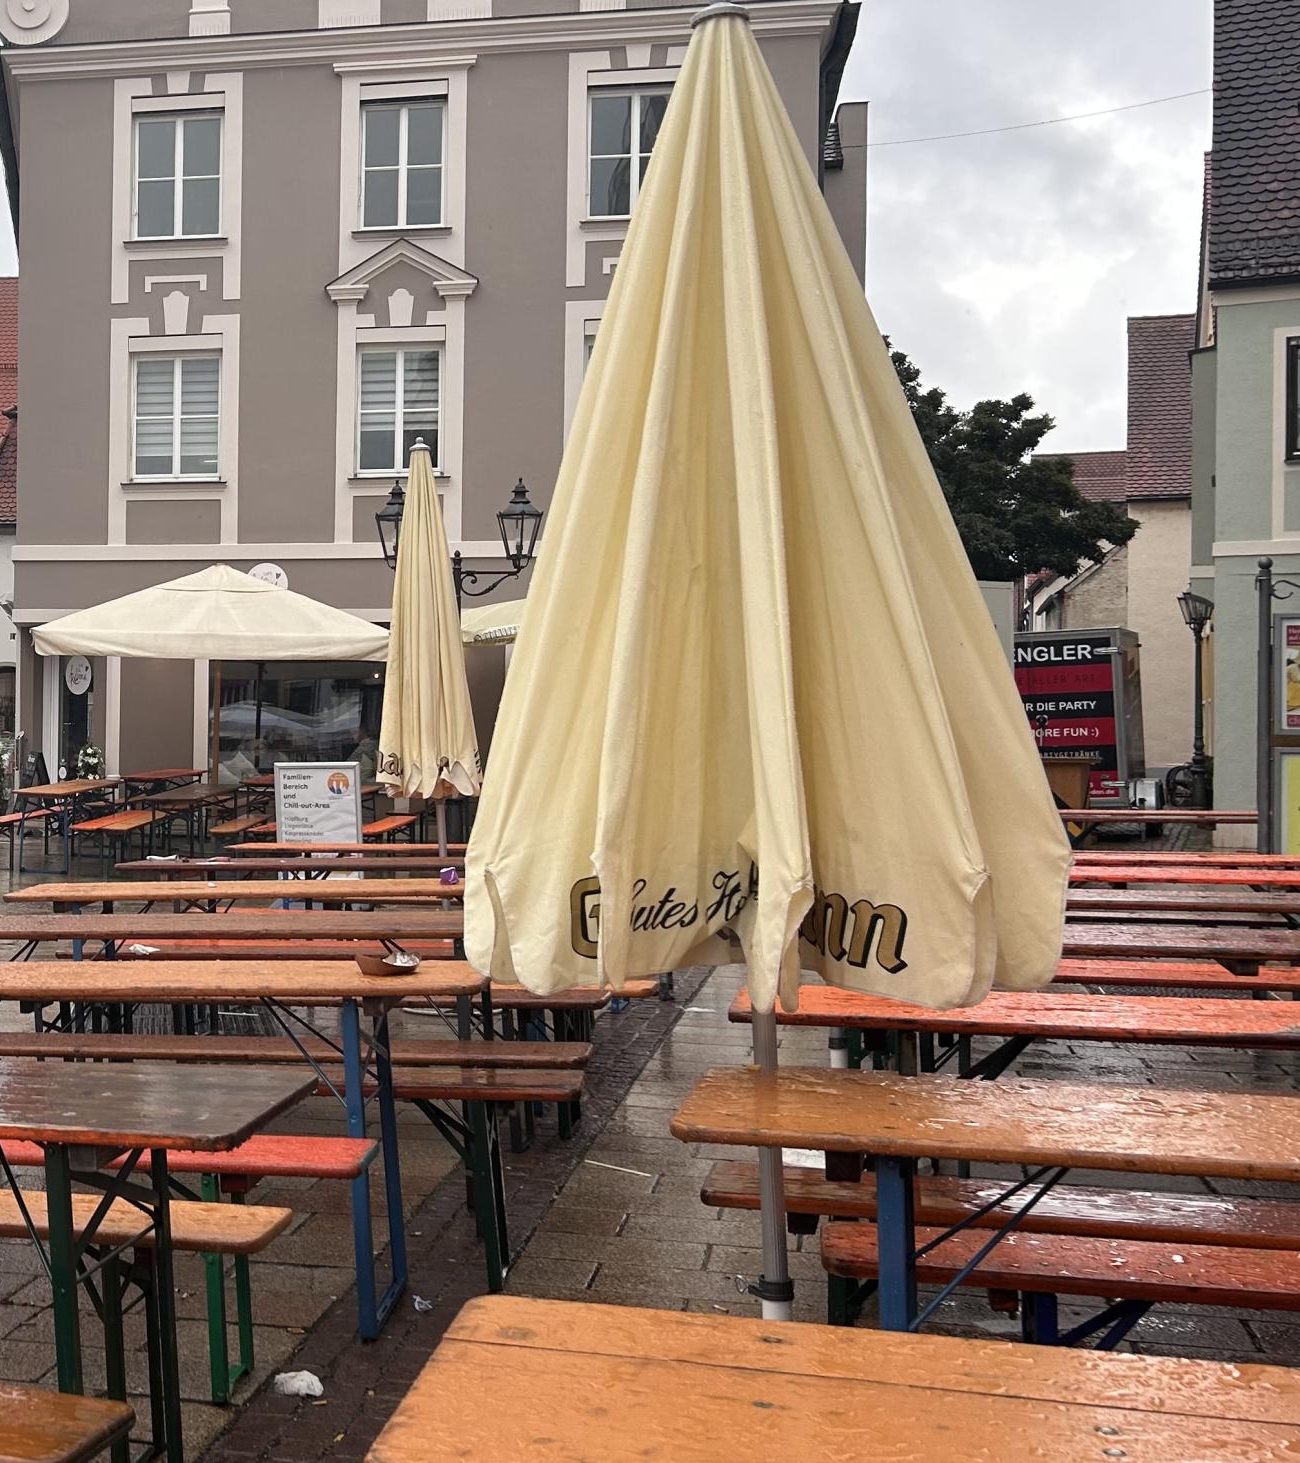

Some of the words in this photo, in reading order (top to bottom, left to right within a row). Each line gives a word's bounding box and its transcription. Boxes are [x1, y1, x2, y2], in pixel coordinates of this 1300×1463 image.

[1014, 644, 1092, 663] NGLER
[1036, 702, 1056, 711] DIE
[1058, 700, 1097, 710] PARTY
[1063, 727, 1088, 737] FUN
[283, 783, 309, 791] Bereich
